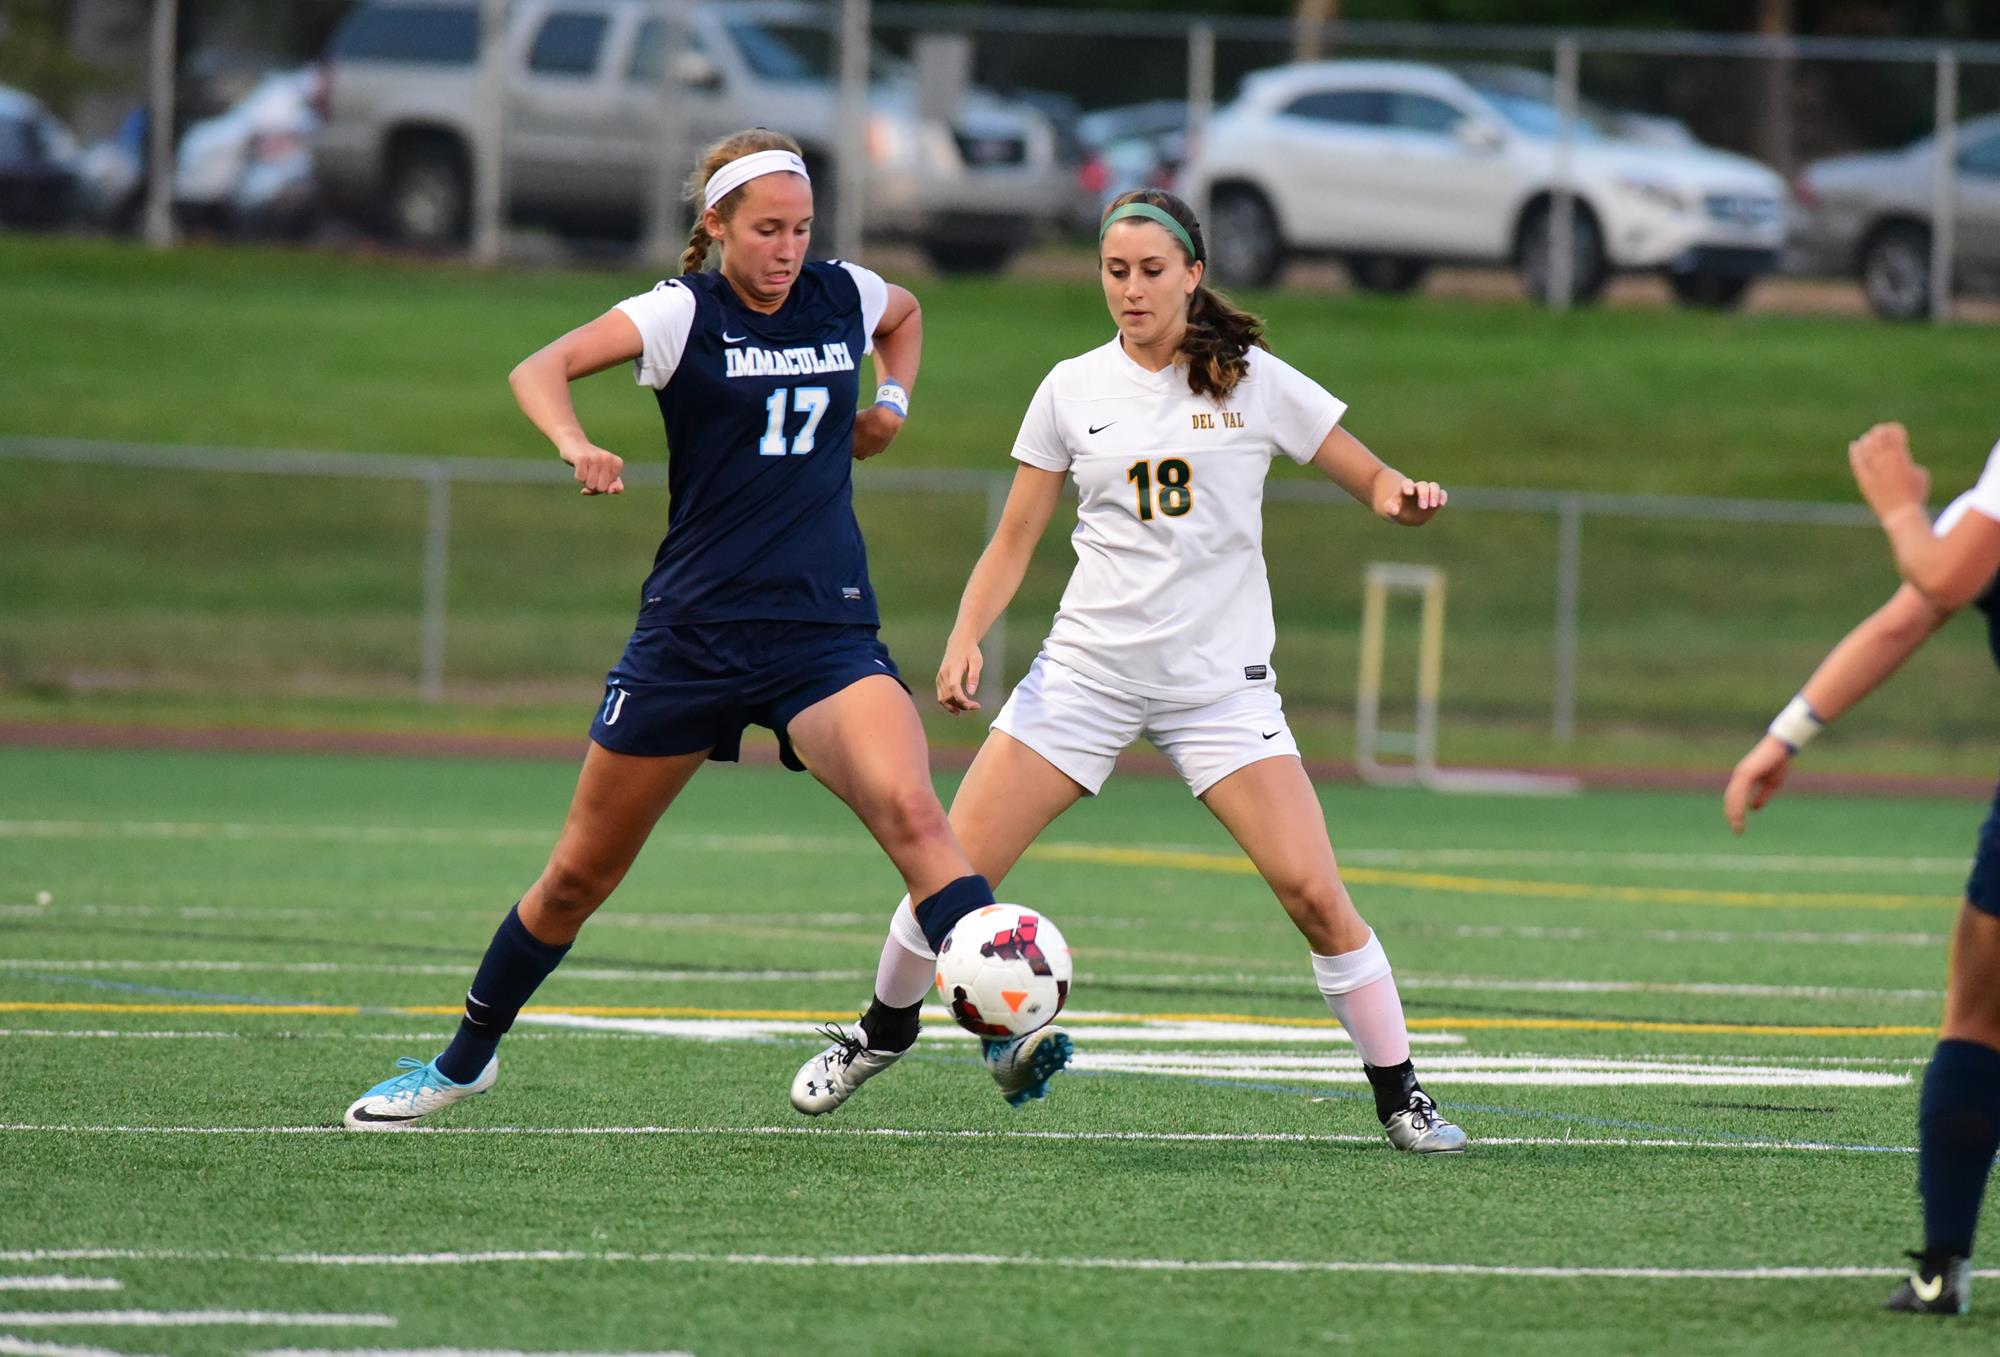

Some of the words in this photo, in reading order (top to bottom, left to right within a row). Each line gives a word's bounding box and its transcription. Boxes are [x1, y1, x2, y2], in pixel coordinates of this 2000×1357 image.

[760, 386, 830, 456] 17
[1191, 413, 1215, 430] DEL
[1222, 411, 1245, 429] VAL
[1127, 457, 1193, 521] 18
